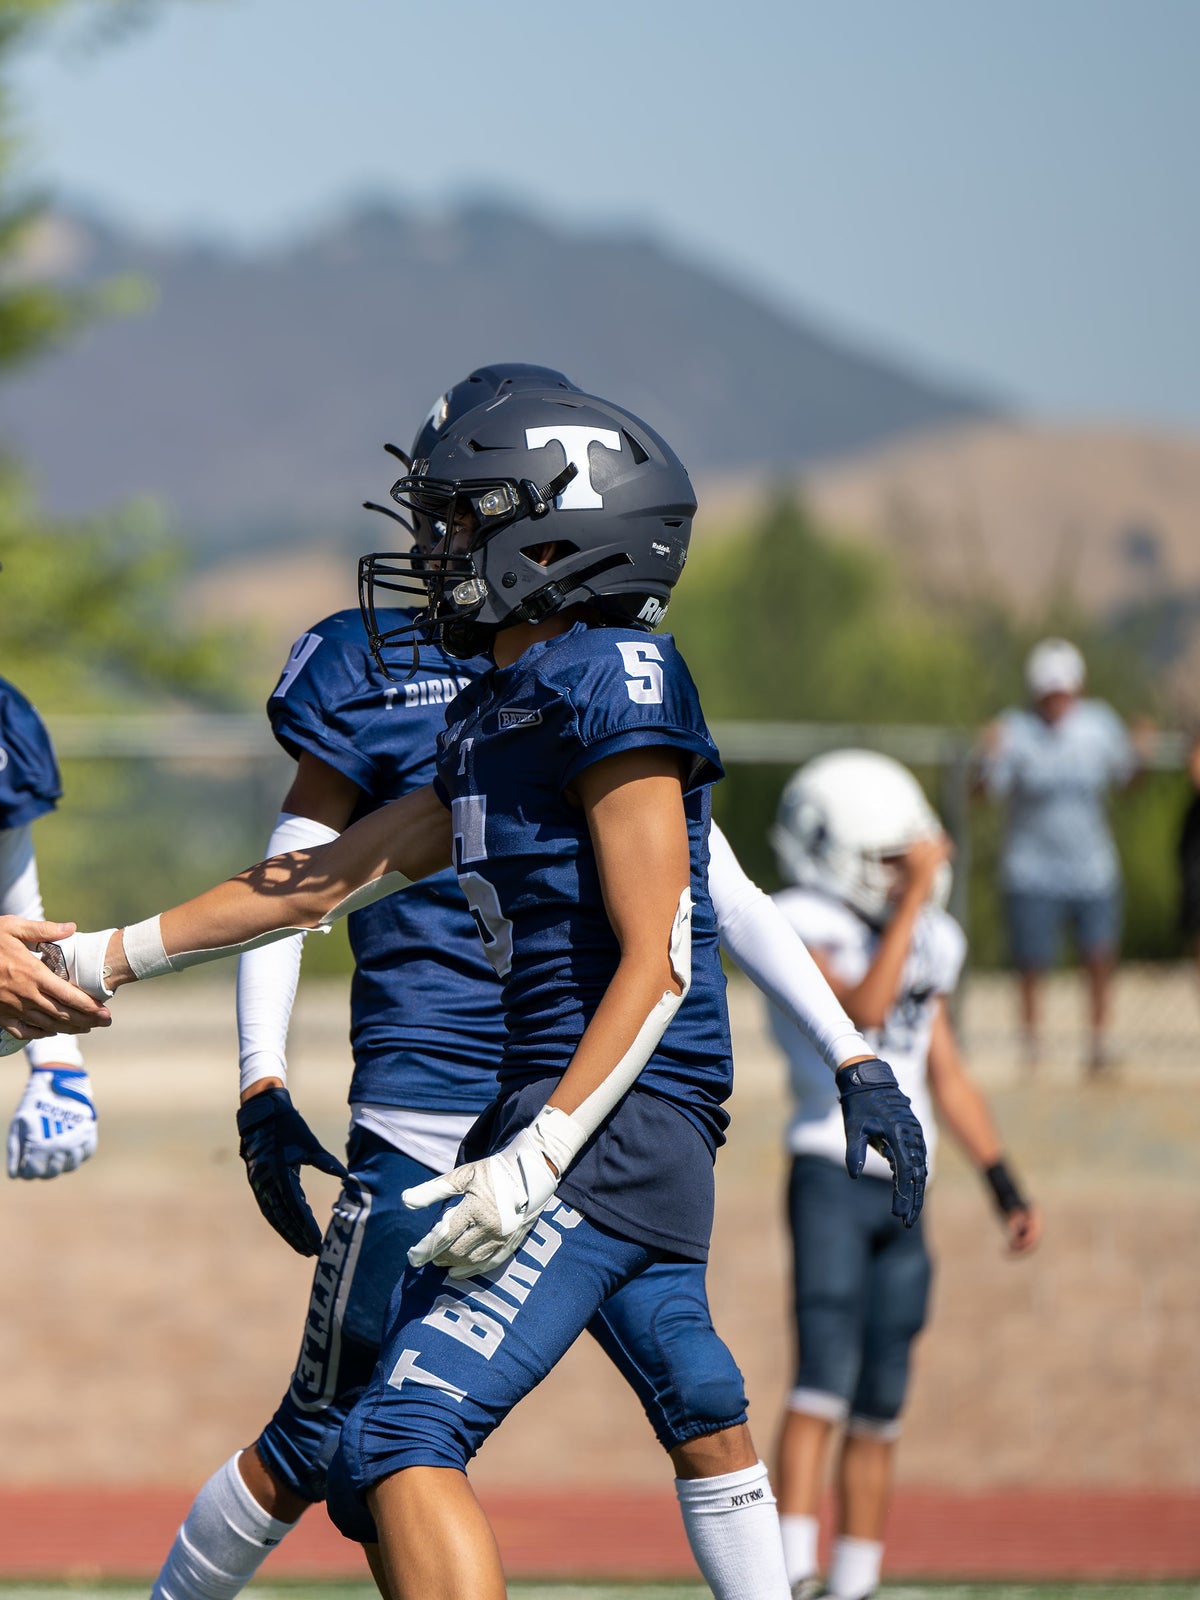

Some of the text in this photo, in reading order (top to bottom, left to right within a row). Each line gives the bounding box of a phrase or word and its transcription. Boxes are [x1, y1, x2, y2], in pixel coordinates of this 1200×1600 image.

[525, 425, 621, 510] T
[383, 687, 399, 710] T
[615, 641, 664, 705] 5
[457, 737, 475, 776] T
[451, 794, 514, 979] 5
[387, 1348, 468, 1404] T
